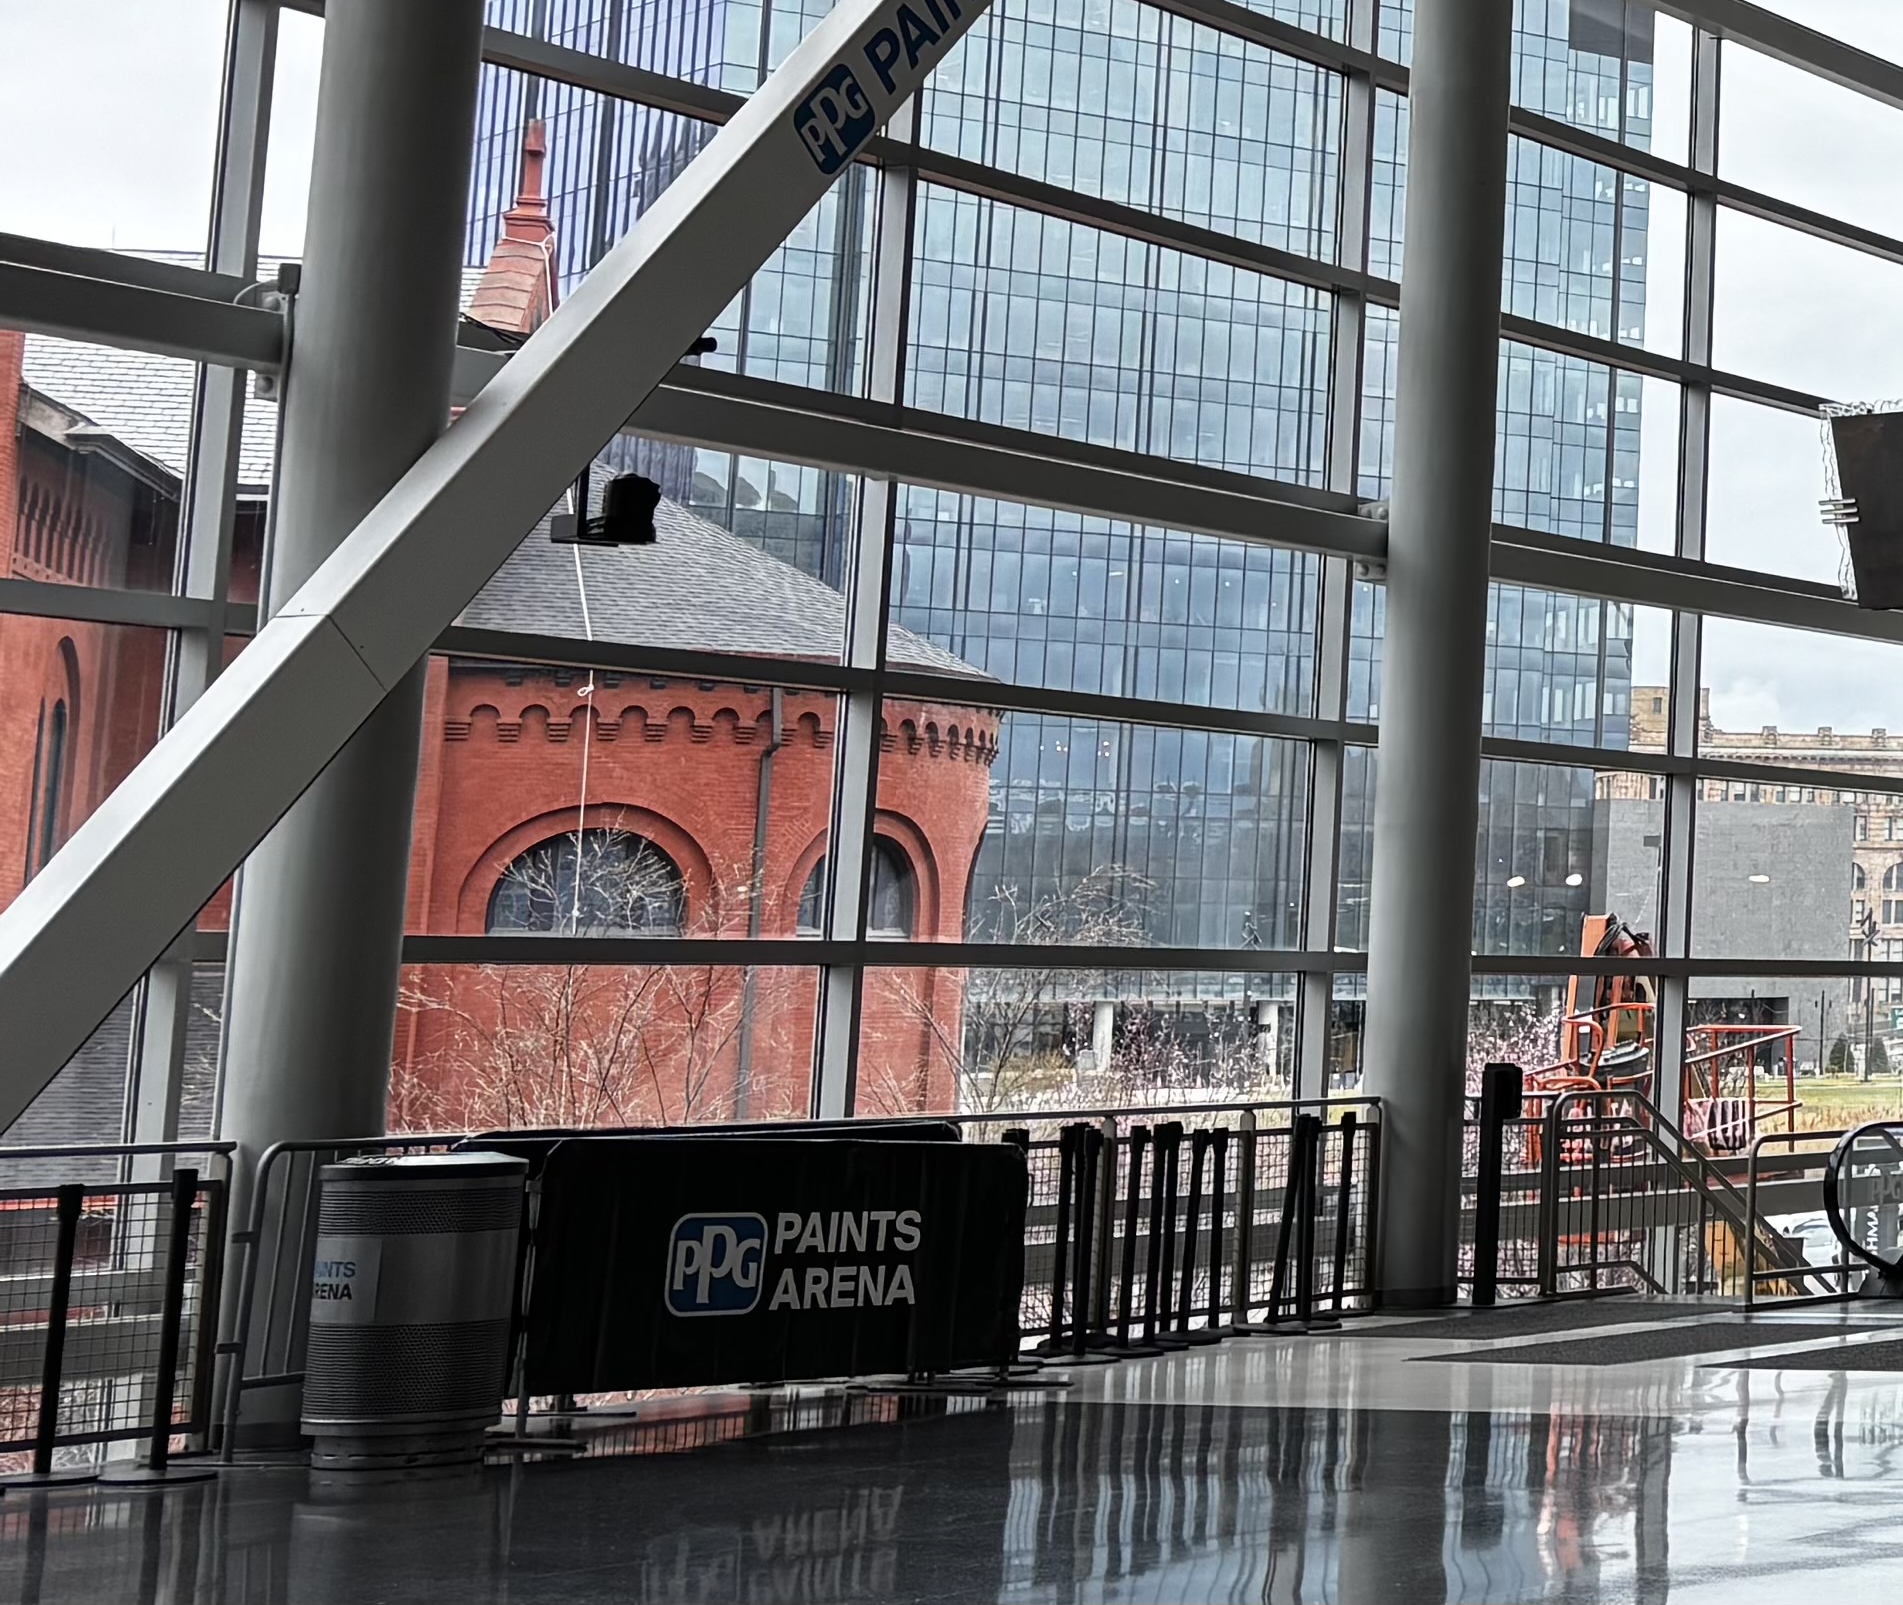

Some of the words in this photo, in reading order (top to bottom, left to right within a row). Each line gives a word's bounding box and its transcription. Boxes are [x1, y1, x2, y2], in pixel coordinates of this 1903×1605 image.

[799, 79, 866, 163] PPG
[672, 1222, 764, 1306] PPG
[774, 1209, 924, 1256] PAINTS
[768, 1262, 917, 1313] ARENA
